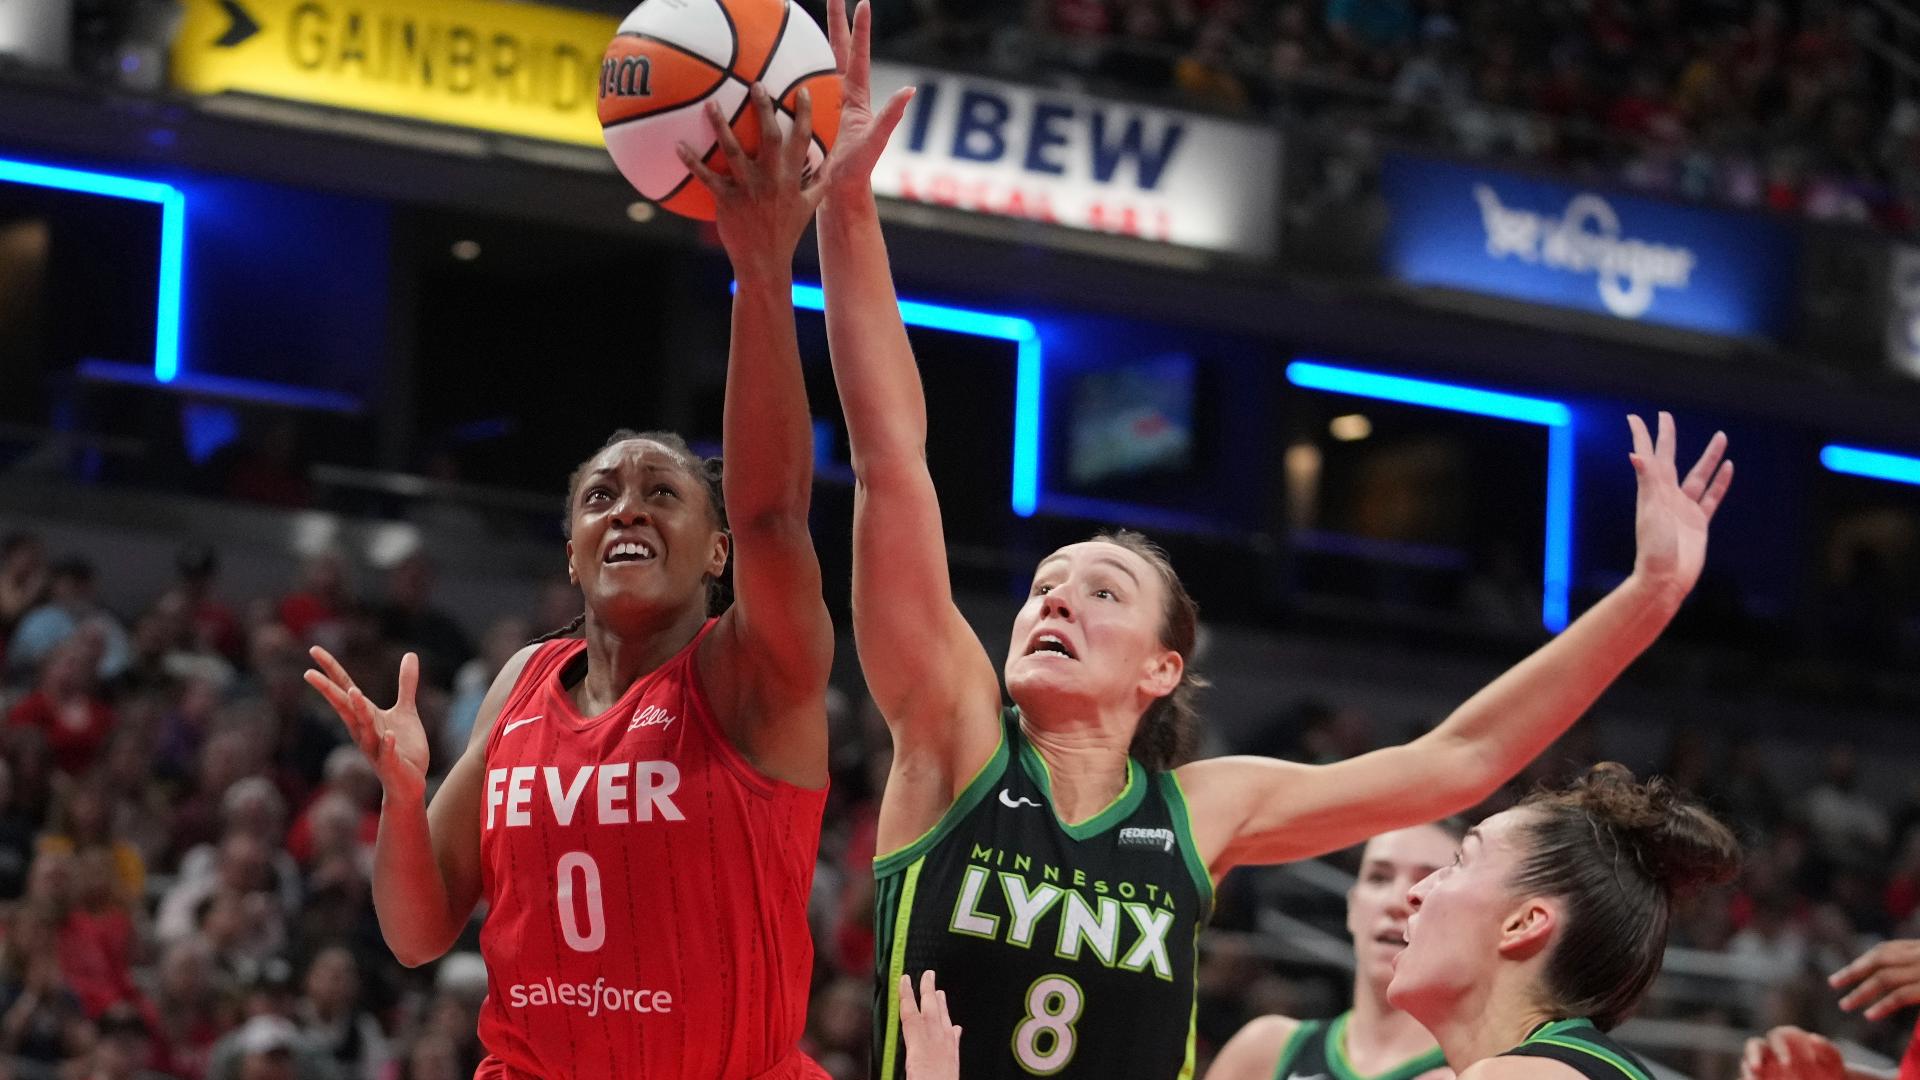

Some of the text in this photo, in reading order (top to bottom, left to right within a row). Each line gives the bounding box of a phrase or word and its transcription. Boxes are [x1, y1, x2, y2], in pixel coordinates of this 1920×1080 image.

[285, 1, 602, 113] GAINBRID
[908, 80, 1184, 191] IBEW
[627, 704, 676, 732] Lilly
[487, 760, 686, 830] FEVER
[557, 851, 606, 953] 0
[949, 864, 1174, 982] LYNX
[971, 843, 1176, 909] MINNESOTA
[509, 976, 673, 1017] salesforce
[1011, 973, 1084, 1076] 8
